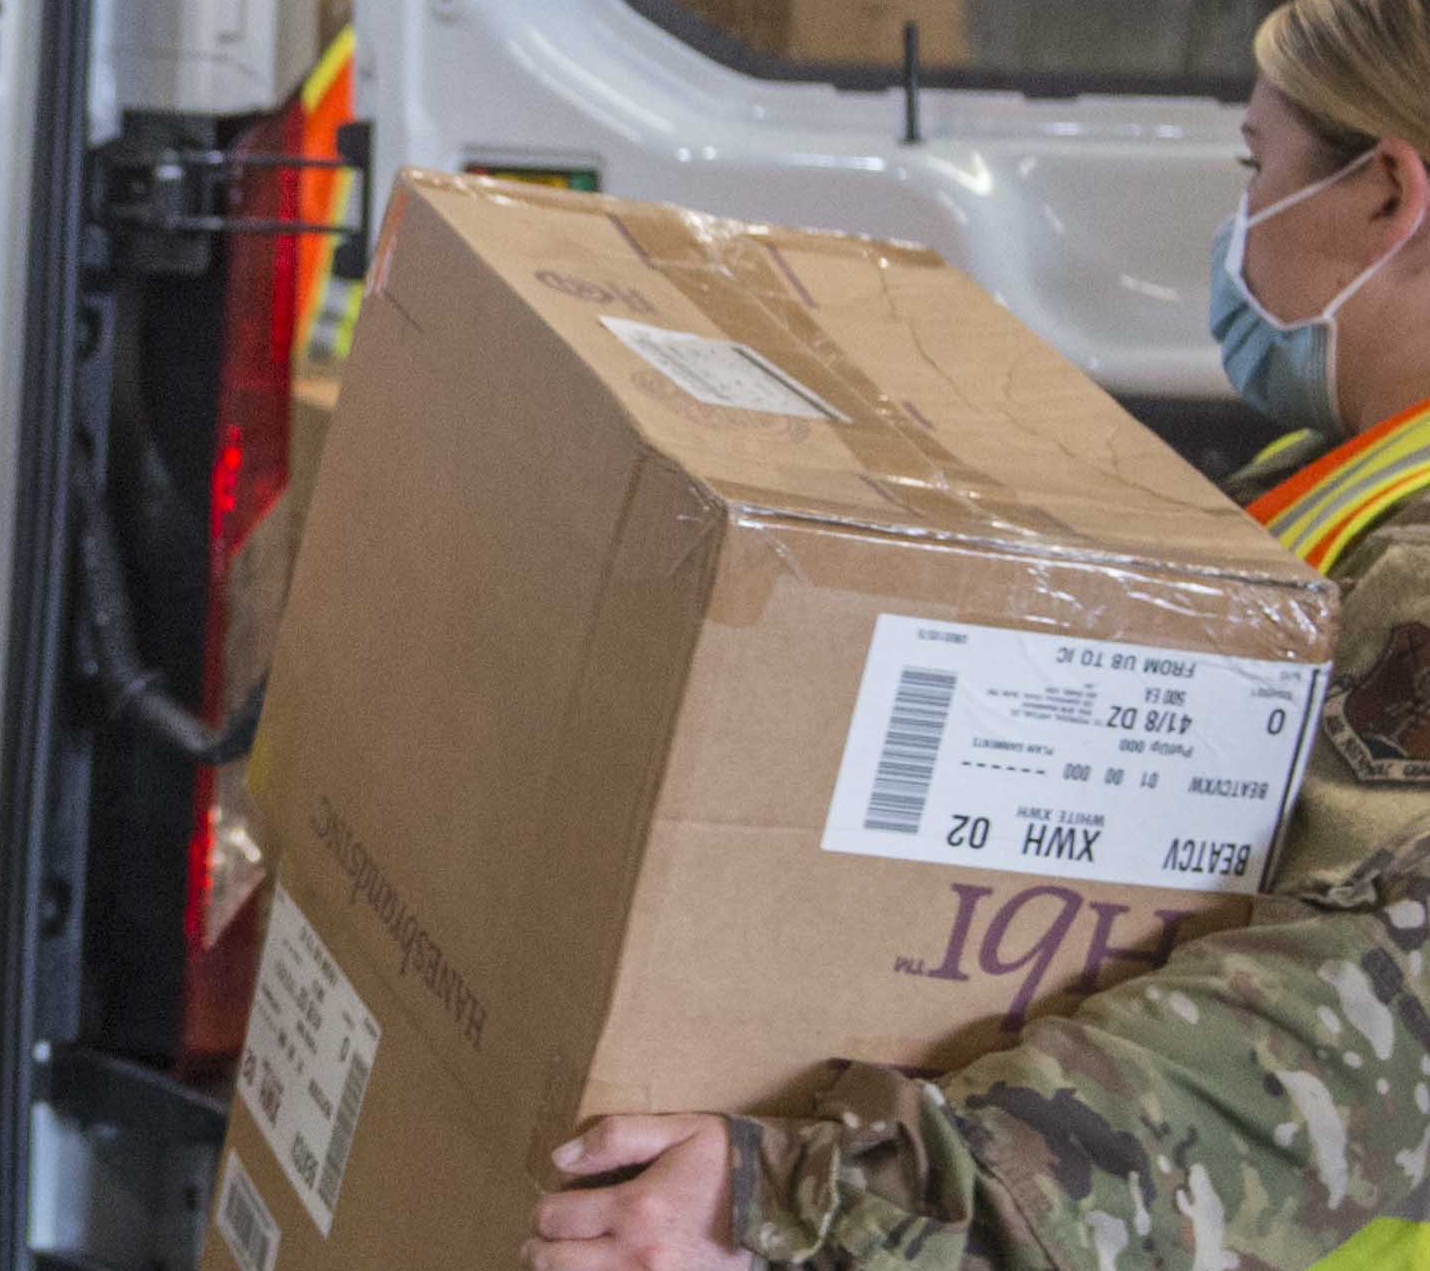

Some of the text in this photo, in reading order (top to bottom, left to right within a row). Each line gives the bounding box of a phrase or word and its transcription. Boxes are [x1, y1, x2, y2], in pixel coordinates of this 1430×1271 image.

[1055, 647, 1197, 678] FROM UB TO IC
[1144, 687, 1187, 706] 500 EA
[1107, 705, 1193, 734] 41/8 DZ
[1062, 763, 1091, 782] 000
[1104, 767, 1125, 786] 00
[1139, 772, 1159, 789] 01
[1016, 806, 1105, 826] WHITE XWH
[946, 814, 1252, 876] BEATCV XWH 02
